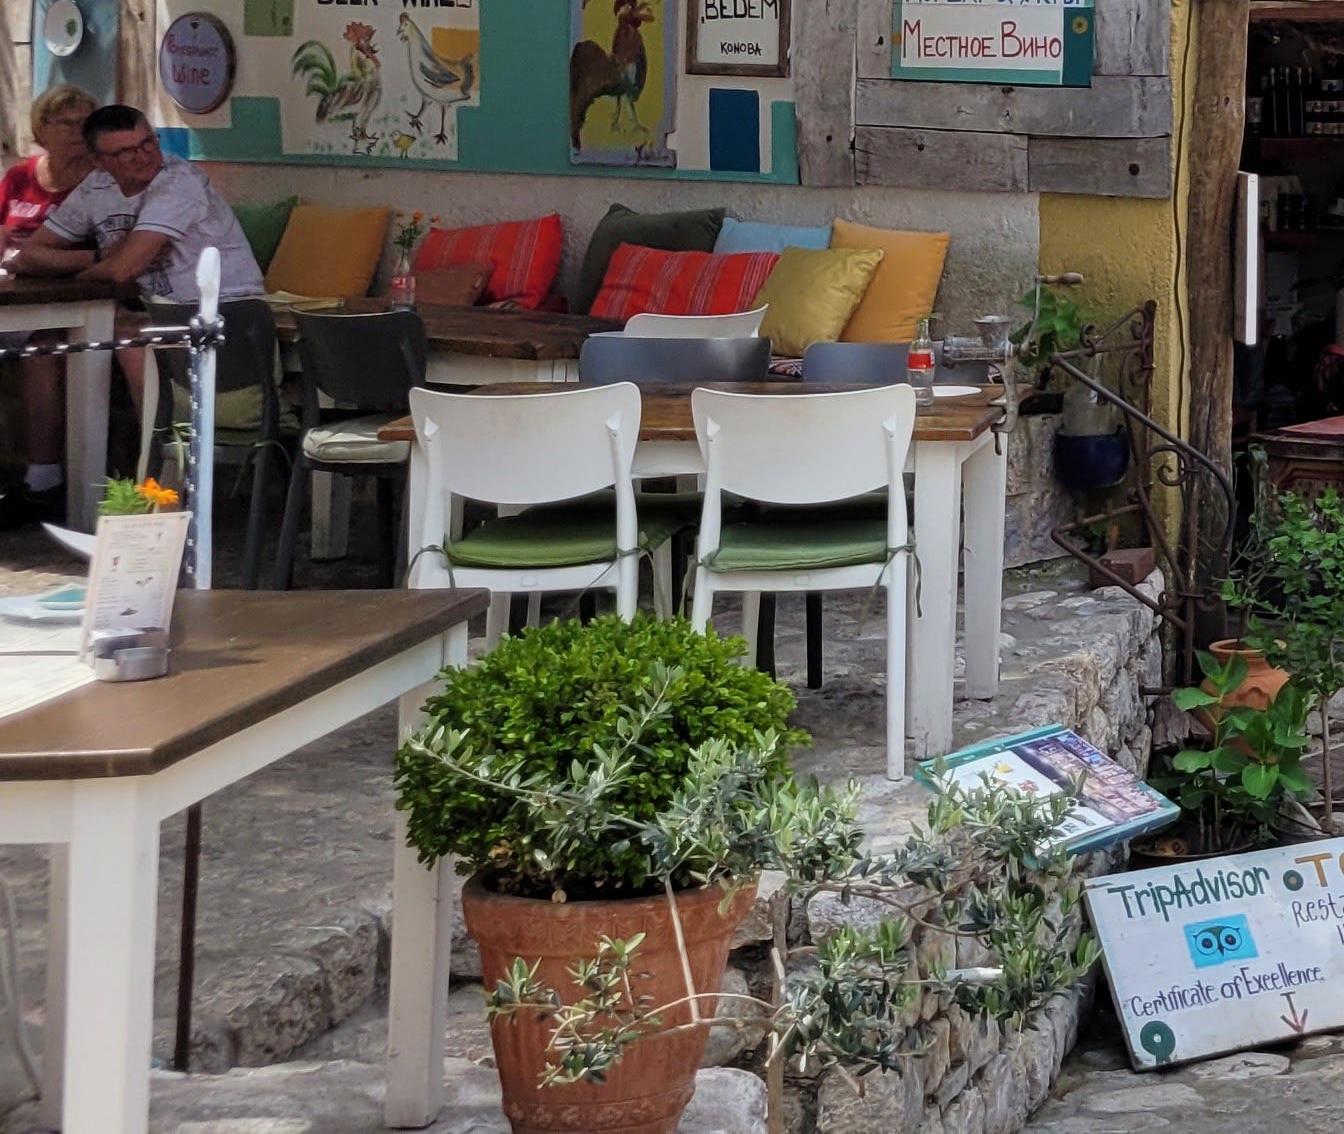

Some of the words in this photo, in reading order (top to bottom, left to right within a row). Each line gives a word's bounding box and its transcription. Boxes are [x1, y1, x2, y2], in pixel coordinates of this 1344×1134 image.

[720, 42, 762, 56] KONOBA
[1107, 866, 1270, 922] TripAdvisor
[1130, 979, 1218, 1017] Certificate
[1220, 975, 1242, 1000] of
